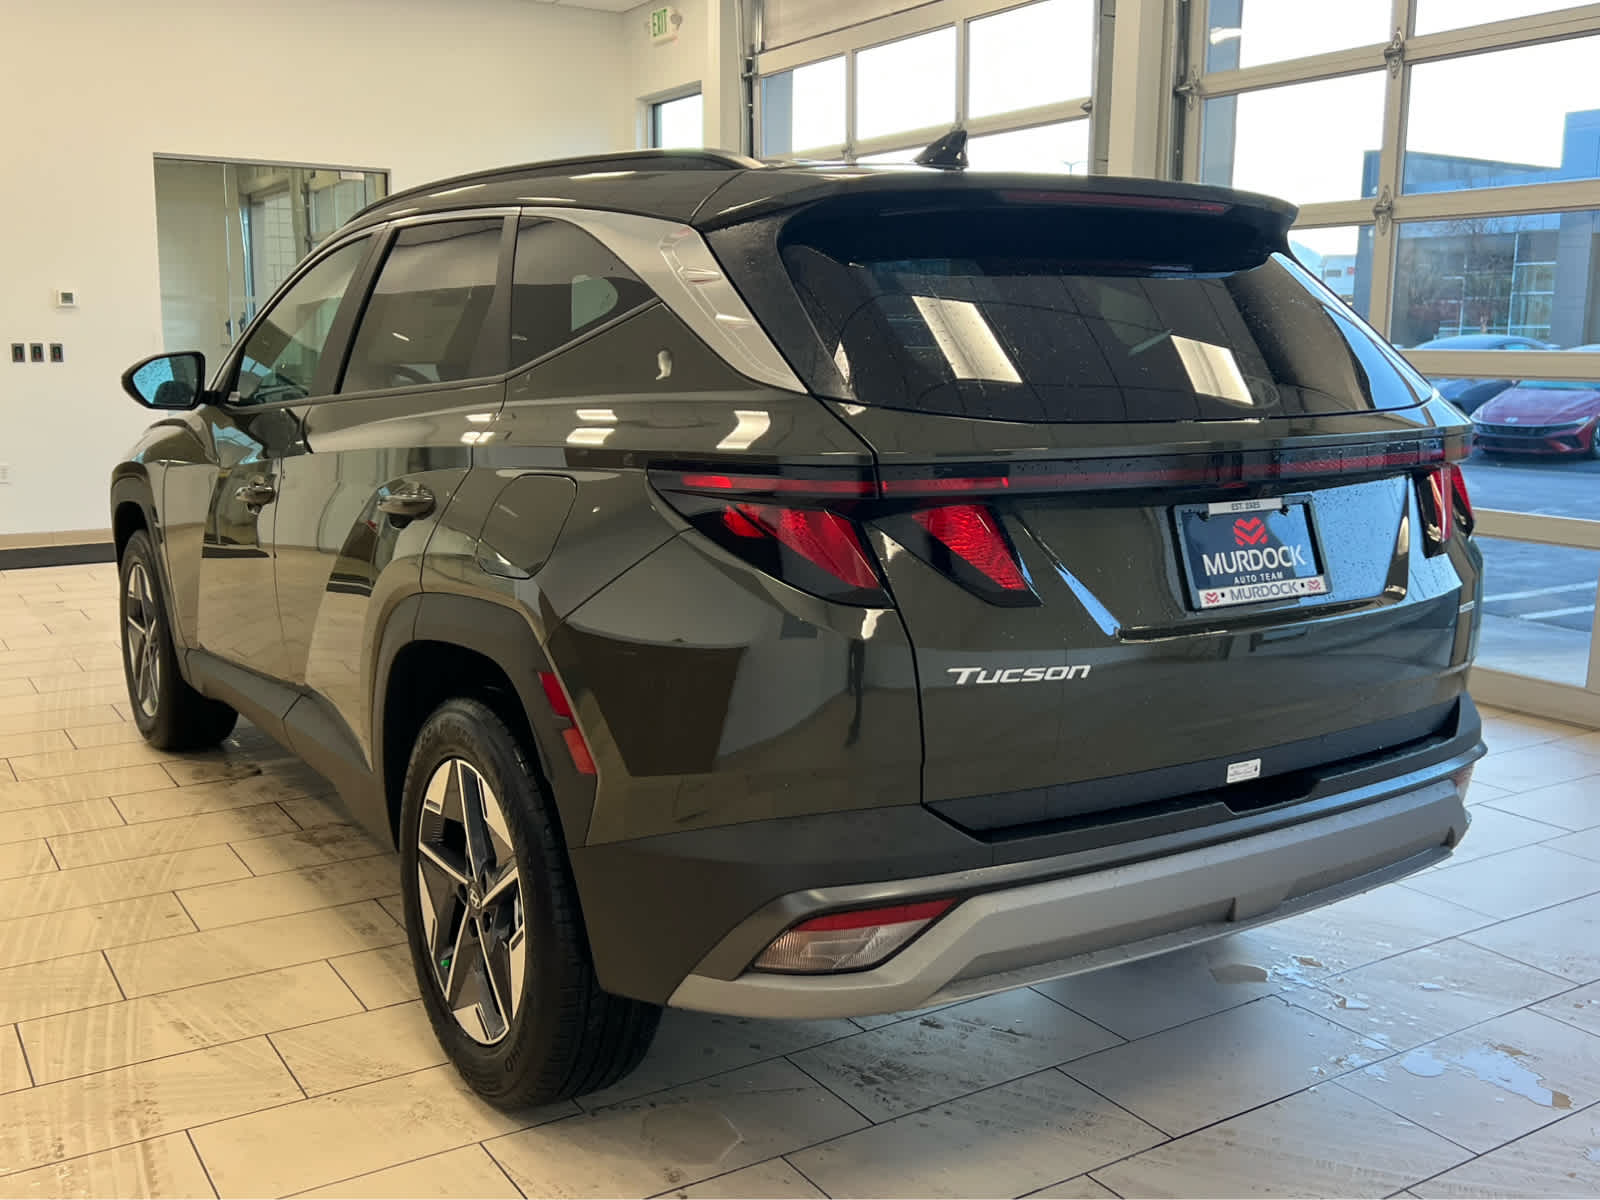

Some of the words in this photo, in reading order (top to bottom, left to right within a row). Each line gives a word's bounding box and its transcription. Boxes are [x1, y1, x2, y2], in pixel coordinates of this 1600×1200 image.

[652, 8, 668, 38] EXIT
[1202, 544, 1307, 577] MURDOCK
[1233, 574, 1257, 585] AUTO
[1260, 571, 1284, 581] TEAM
[1229, 581, 1299, 601] MURDOCK
